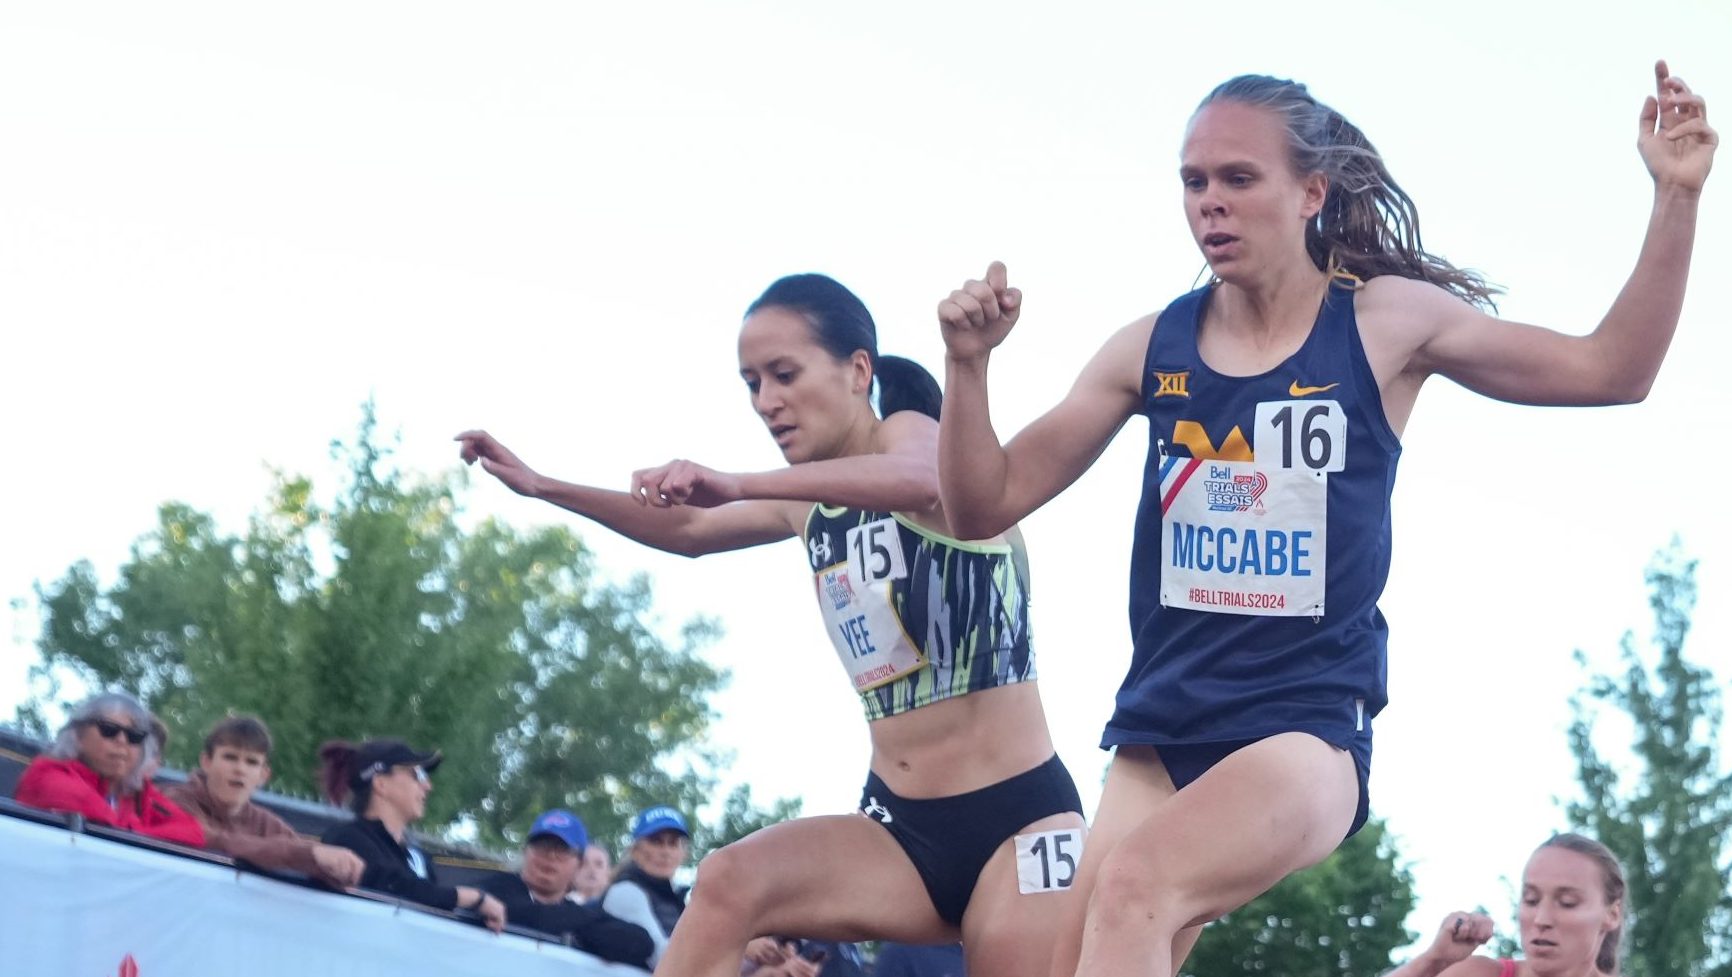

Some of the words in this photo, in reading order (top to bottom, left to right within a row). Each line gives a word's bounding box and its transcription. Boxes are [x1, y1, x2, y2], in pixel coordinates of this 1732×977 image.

[1153, 371, 1190, 397] XII
[1270, 405, 1331, 469] 16
[1204, 480, 1250, 495] TRIALS
[1210, 466, 1231, 480] Bell
[1208, 493, 1253, 507] ESSAIS
[853, 525, 892, 583] 15
[1171, 522, 1313, 577] MCCABE
[1188, 588, 1286, 610] #BELLTRIALS2024
[838, 614, 877, 660] YEE
[1031, 834, 1077, 889] 15
